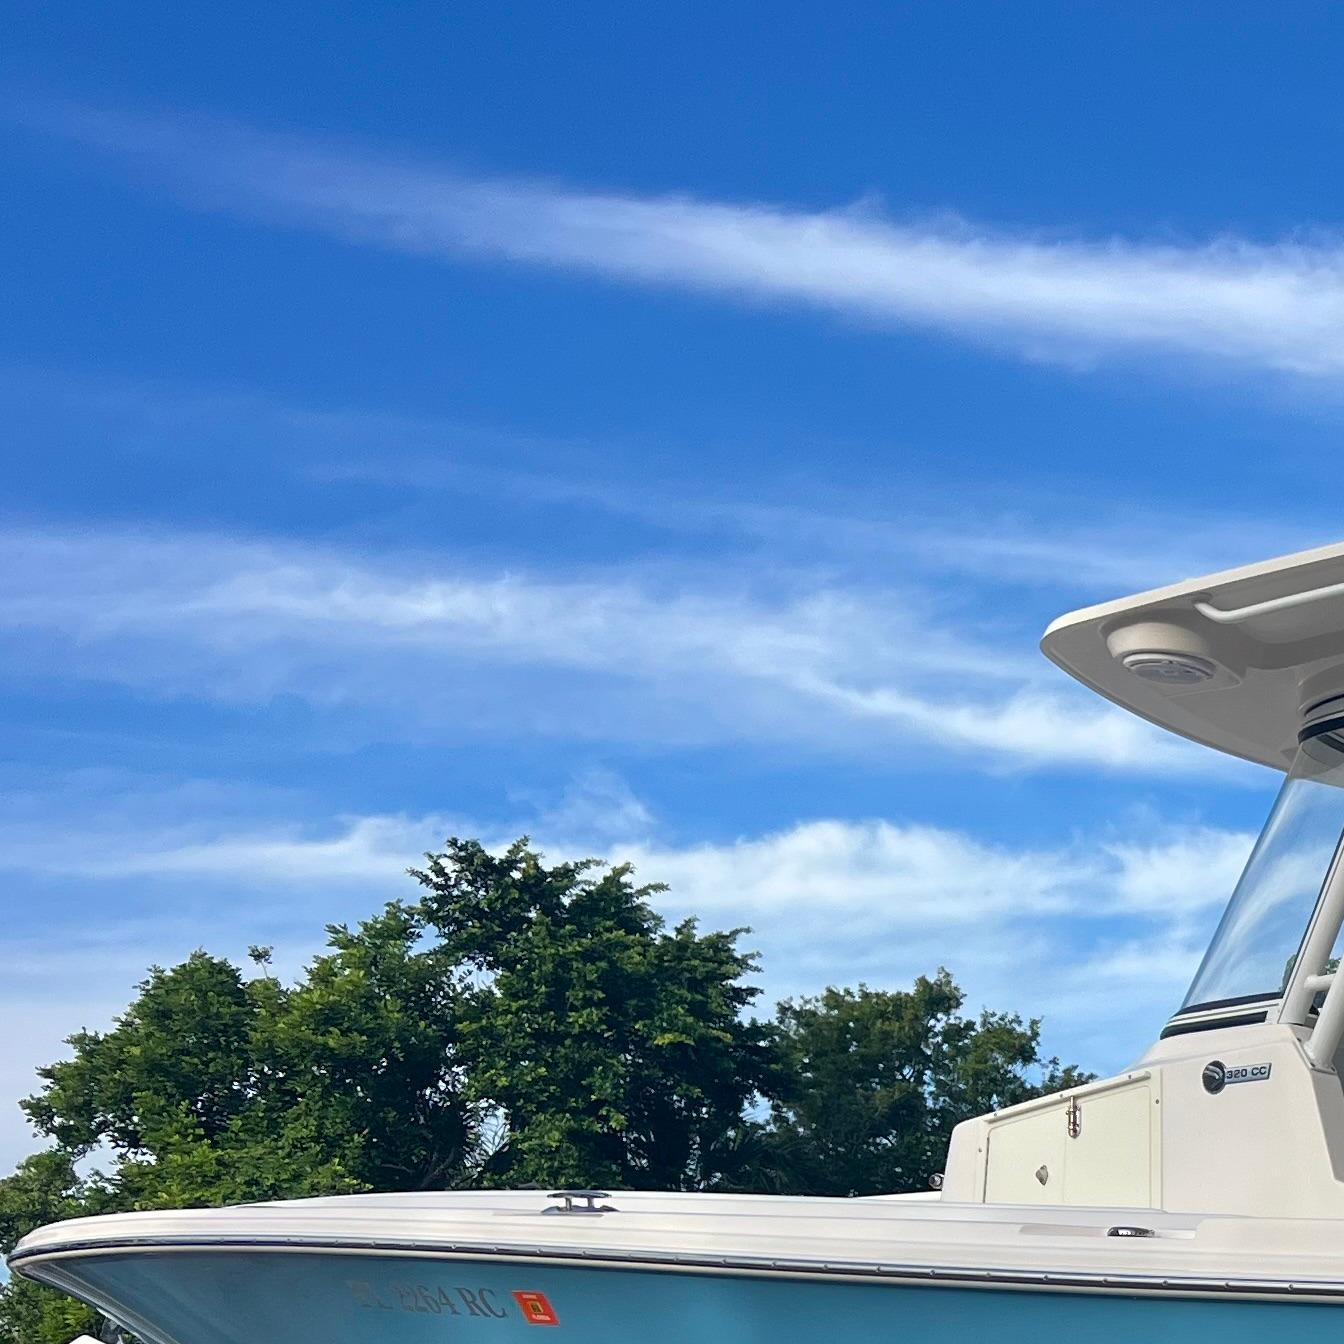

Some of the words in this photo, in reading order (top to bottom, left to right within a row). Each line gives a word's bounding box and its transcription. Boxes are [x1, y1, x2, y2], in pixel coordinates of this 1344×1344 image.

[1226, 1069, 1247, 1079] 320
[1251, 1066, 1267, 1076] CC
[453, 1286, 508, 1319] RC
